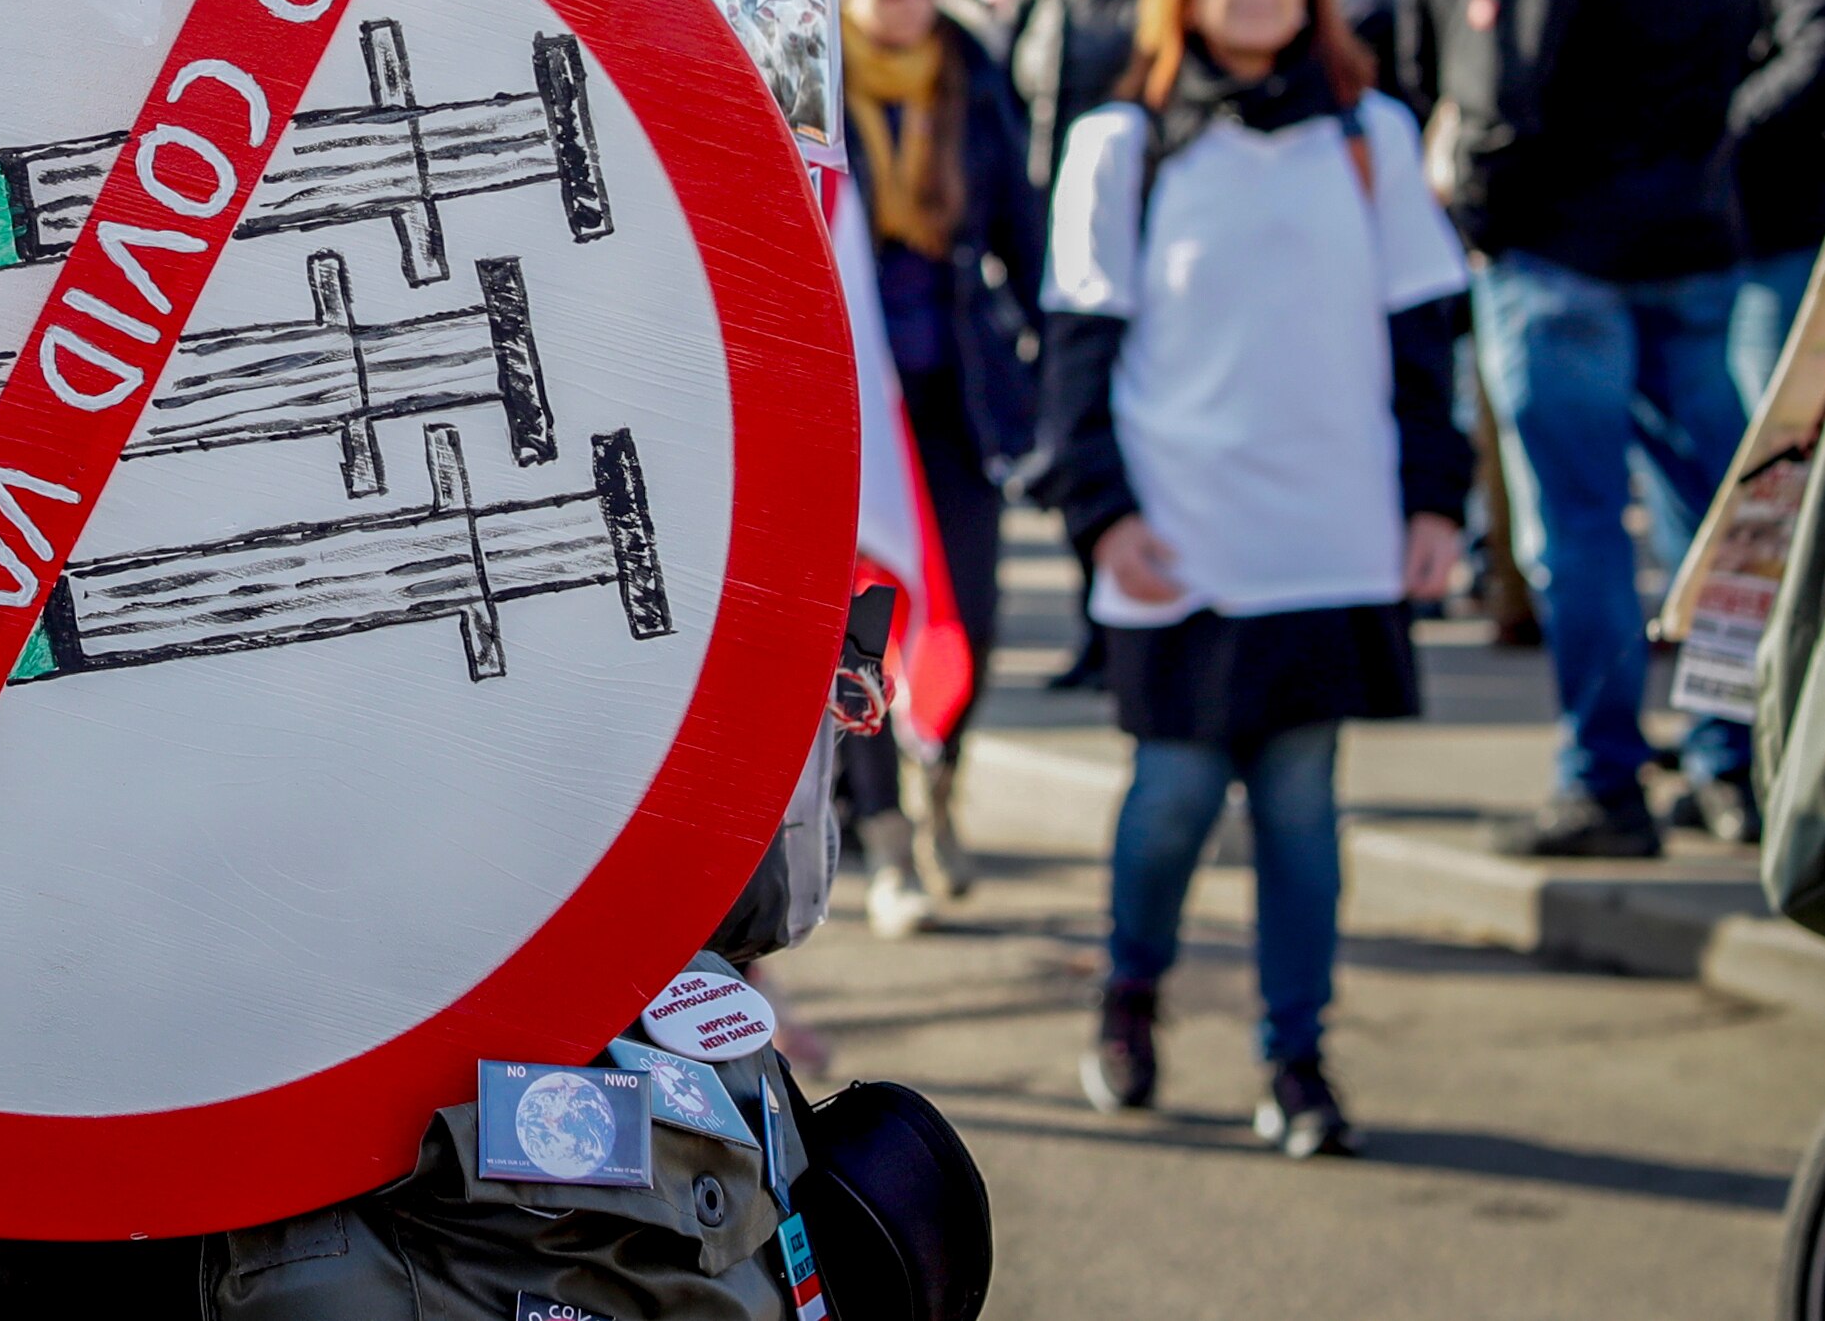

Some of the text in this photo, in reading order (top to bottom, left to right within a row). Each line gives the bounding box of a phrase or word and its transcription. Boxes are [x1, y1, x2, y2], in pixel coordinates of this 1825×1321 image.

[38, 58, 271, 413] COVID
[648, 981, 746, 1021] KONTROLLGRUPPE
[668, 978, 708, 998] JE SUIS
[696, 1011, 749, 1036] IMPFUNG
[698, 1020, 769, 1051] NEIN DANKE!
[507, 1065, 638, 1089] NO NWO
